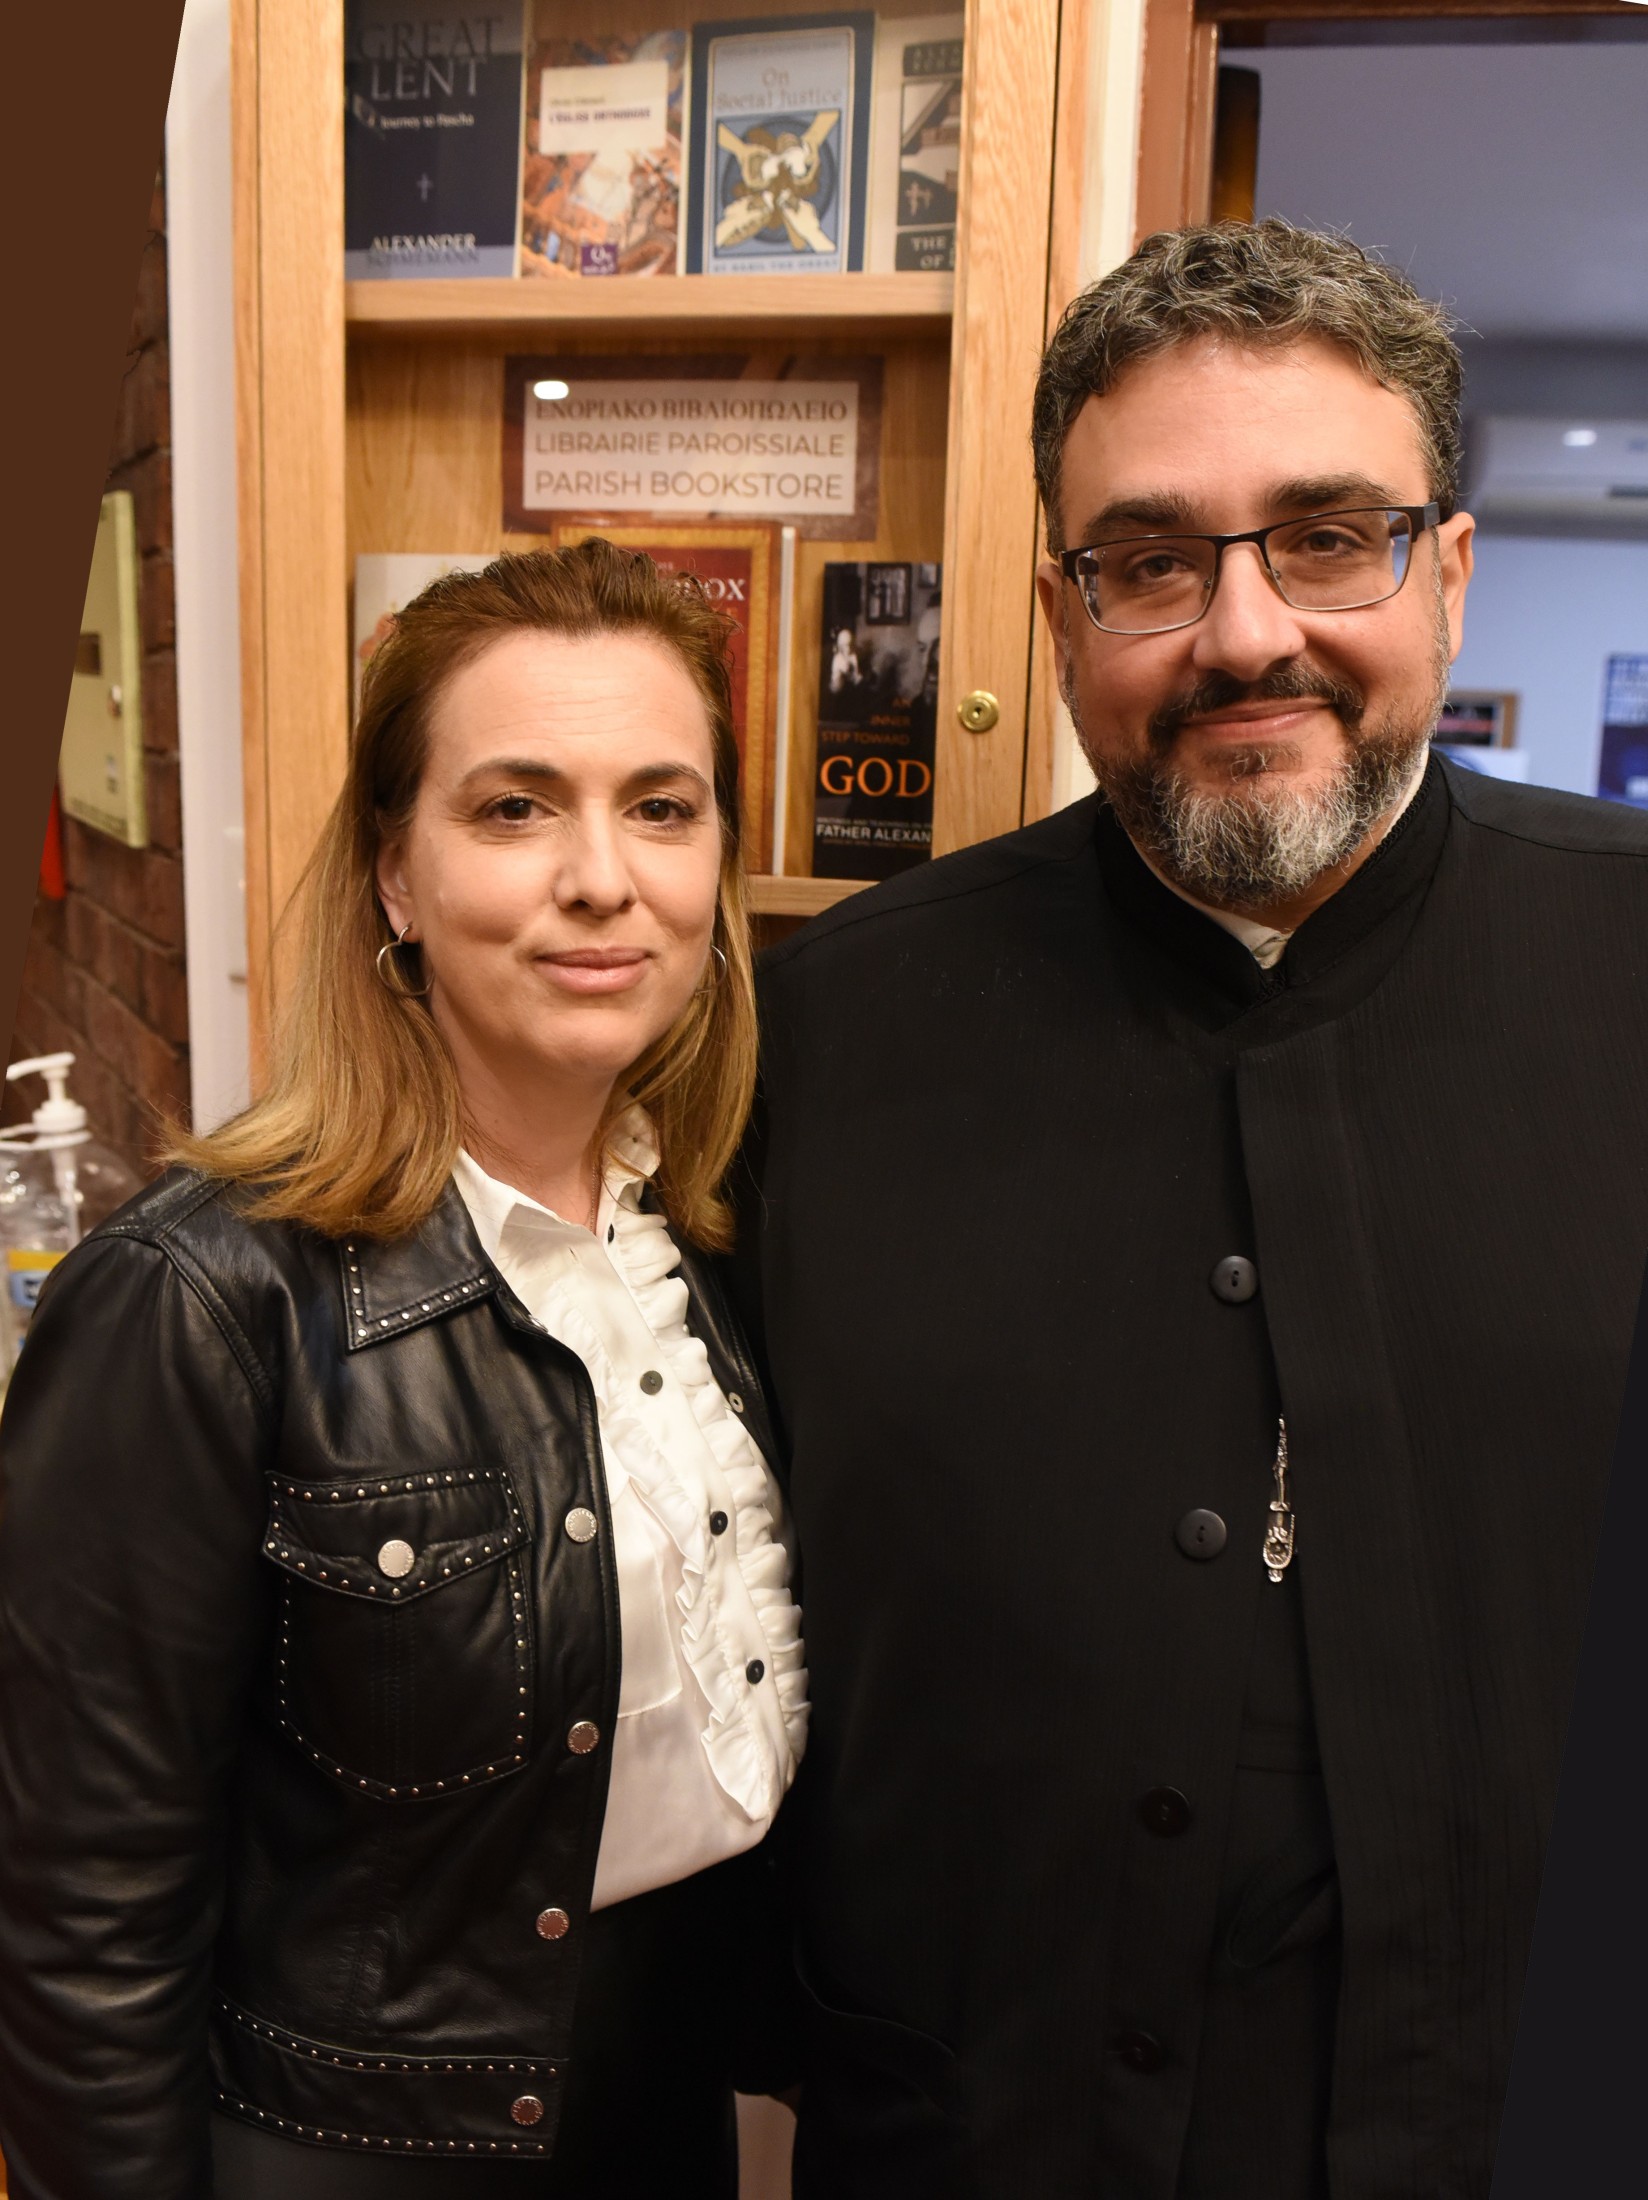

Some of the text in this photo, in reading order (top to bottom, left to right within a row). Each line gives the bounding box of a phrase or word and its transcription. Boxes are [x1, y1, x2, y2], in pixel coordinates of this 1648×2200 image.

[358, 17, 503, 60] GREAT
[371, 57, 488, 100] LENT
[762, 67, 789, 88] On
[717, 87, 841, 109] Social Justice
[370, 233, 477, 252] ALEXANDER
[911, 235, 946, 250] THE
[920, 254, 945, 269] OF
[535, 399, 847, 421] ΕΝΟΡΙΑΚΟ ΒΙΒΛΙΟΠΩΛΕΙΟ
[535, 431, 844, 457] LIBRAIRIE PAROISSIALE
[535, 470, 842, 499] PARISH BOOKSTORE
[822, 731, 909, 746] STEP TOWARD
[820, 755, 931, 797] GOD
[816, 823, 871, 840] FATHER
[874, 827, 931, 843] ALEXAN
